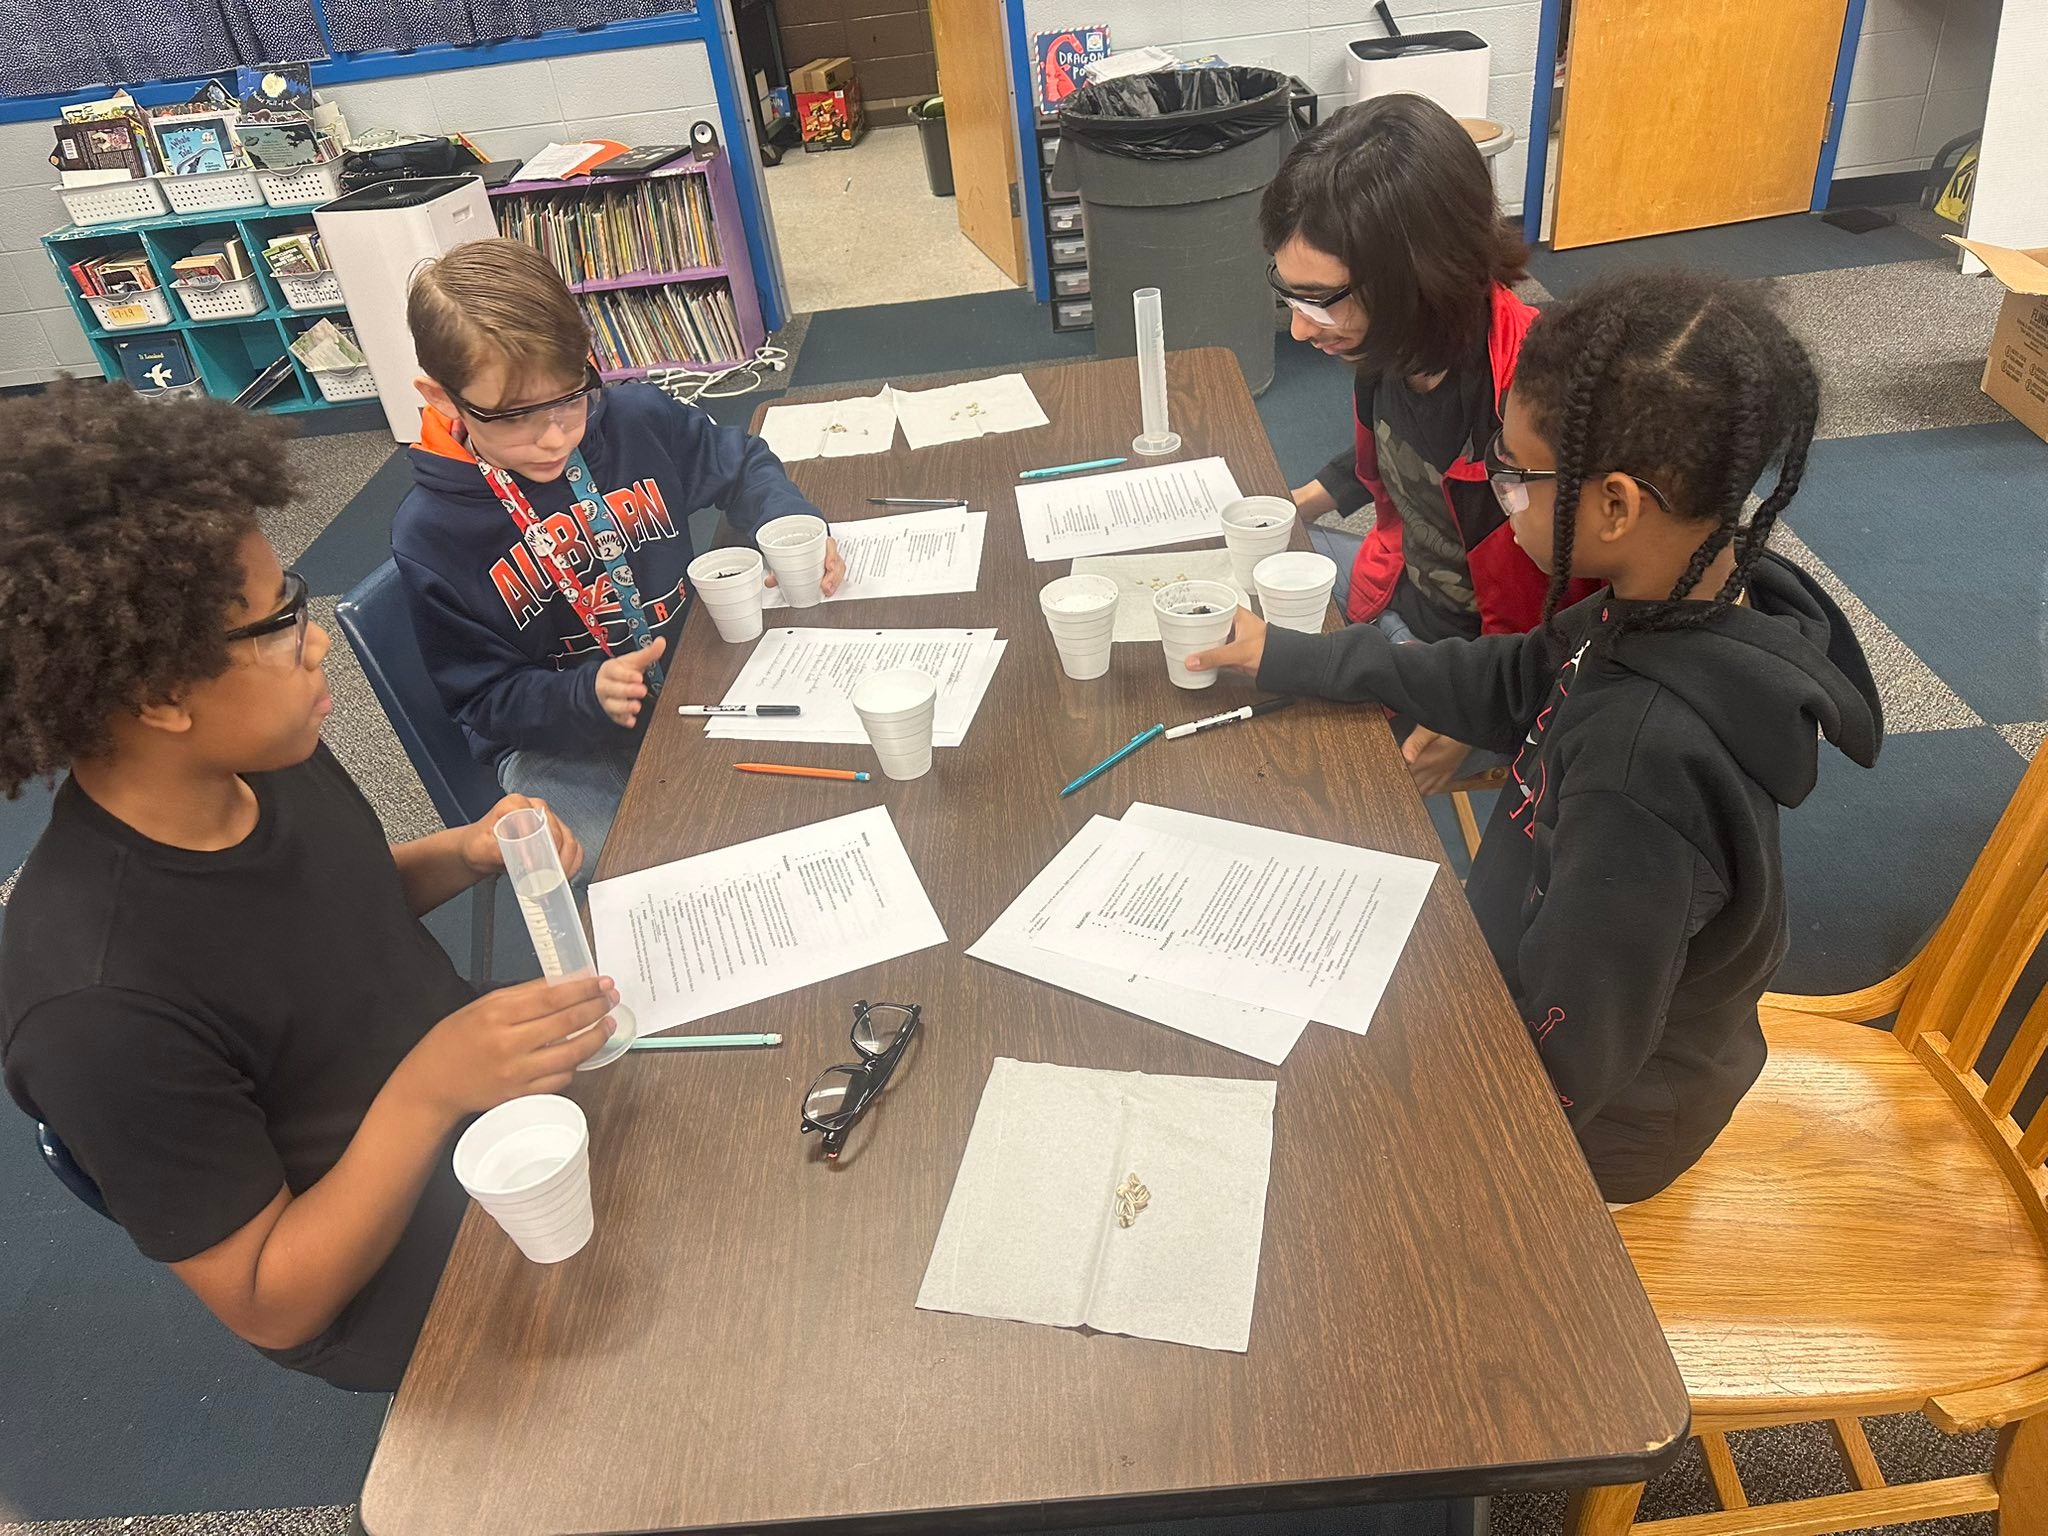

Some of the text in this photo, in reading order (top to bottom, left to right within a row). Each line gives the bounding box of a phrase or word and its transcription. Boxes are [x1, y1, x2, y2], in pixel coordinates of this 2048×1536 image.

[1059, 51, 1105, 65] DRAGON
[1073, 66, 1086, 80] PO
[144, 352, 164, 360] Looked
[604, 547, 613, 557] 2
